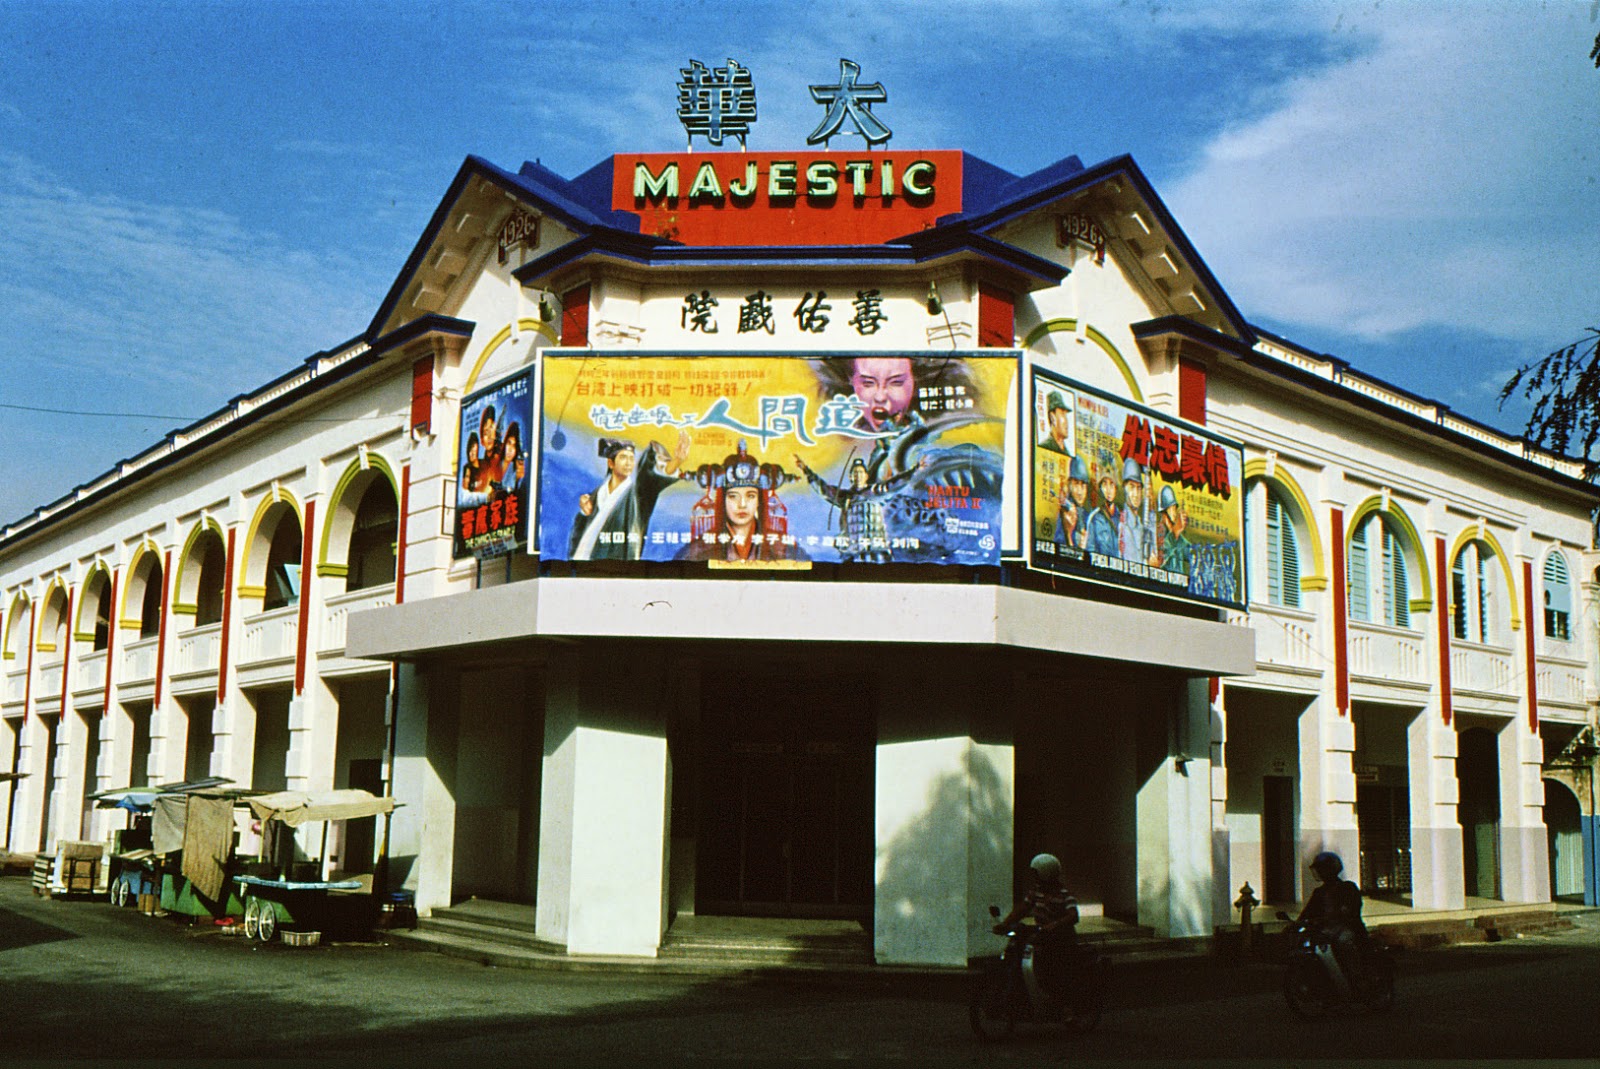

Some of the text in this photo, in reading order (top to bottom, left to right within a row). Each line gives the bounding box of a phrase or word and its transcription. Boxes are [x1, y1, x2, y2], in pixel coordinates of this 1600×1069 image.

[632, 159, 937, 200] MAJESTIC
[503, 212, 532, 247] 1926
[1066, 214, 1098, 244] 1926
[924, 497, 968, 509] JELITA
[927, 485, 970, 497] HANTU
